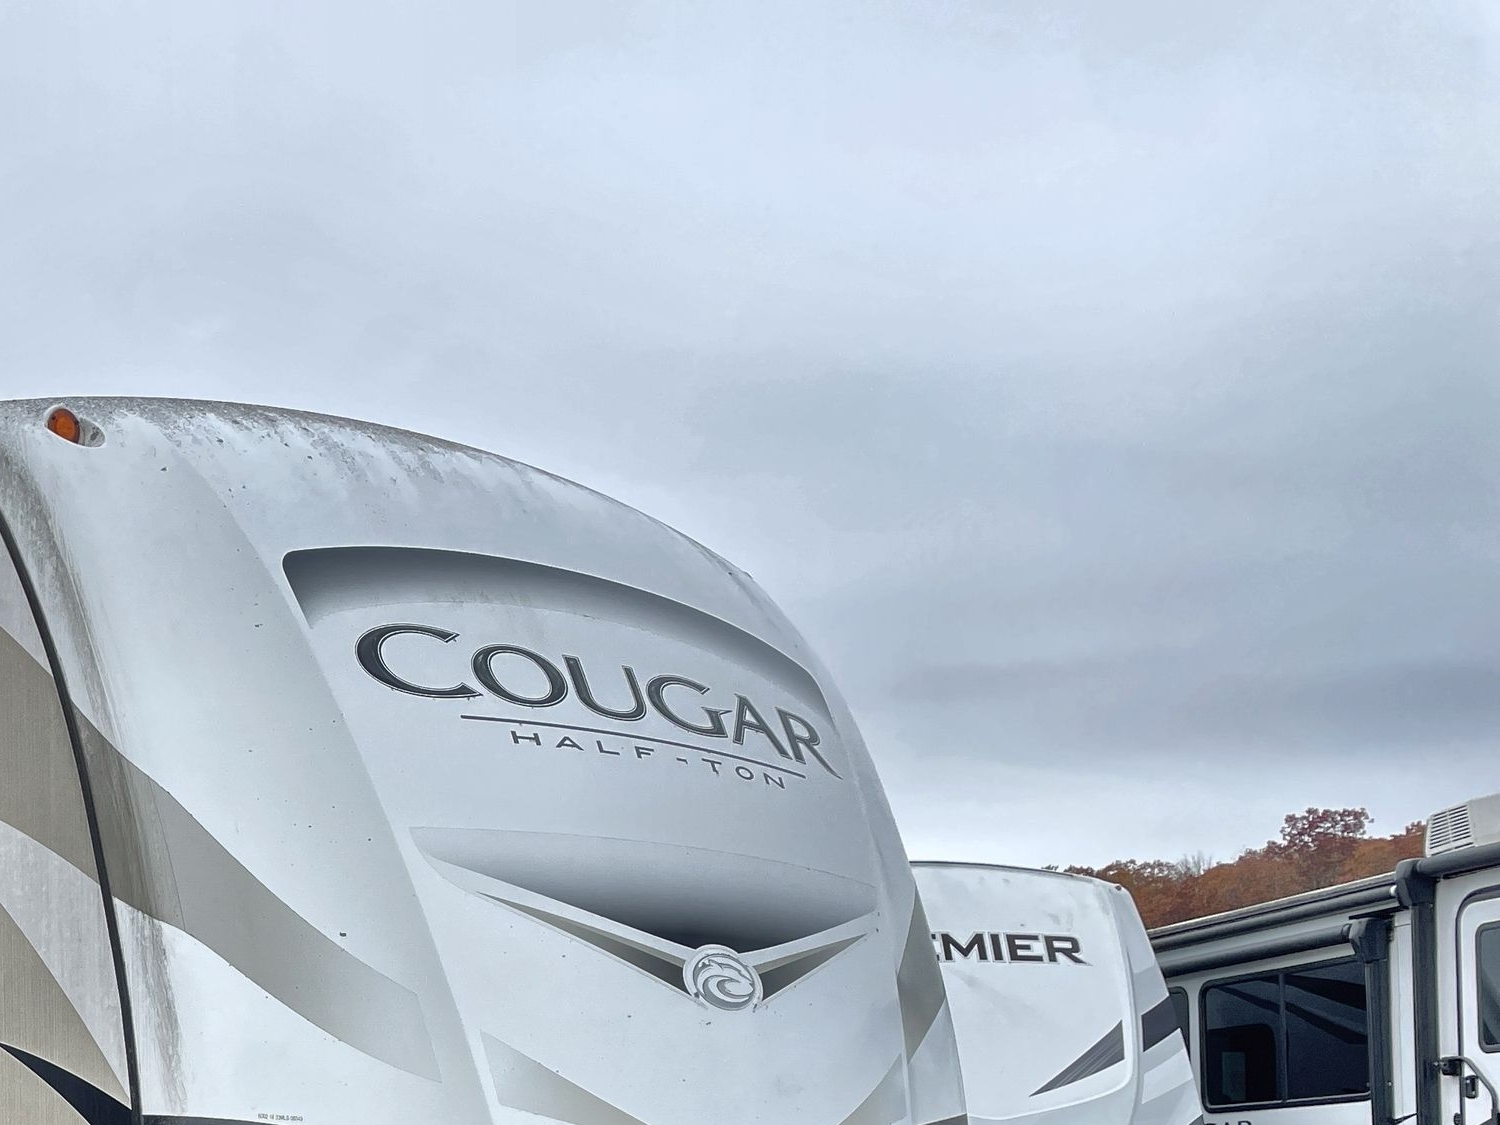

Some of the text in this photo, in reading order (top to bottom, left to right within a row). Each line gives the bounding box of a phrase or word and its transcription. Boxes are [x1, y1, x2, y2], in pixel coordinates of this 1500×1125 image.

[355, 623, 842, 779] COUGAR
[510, 730, 786, 790] HALF-TON
[931, 931, 1092, 966] MIER
